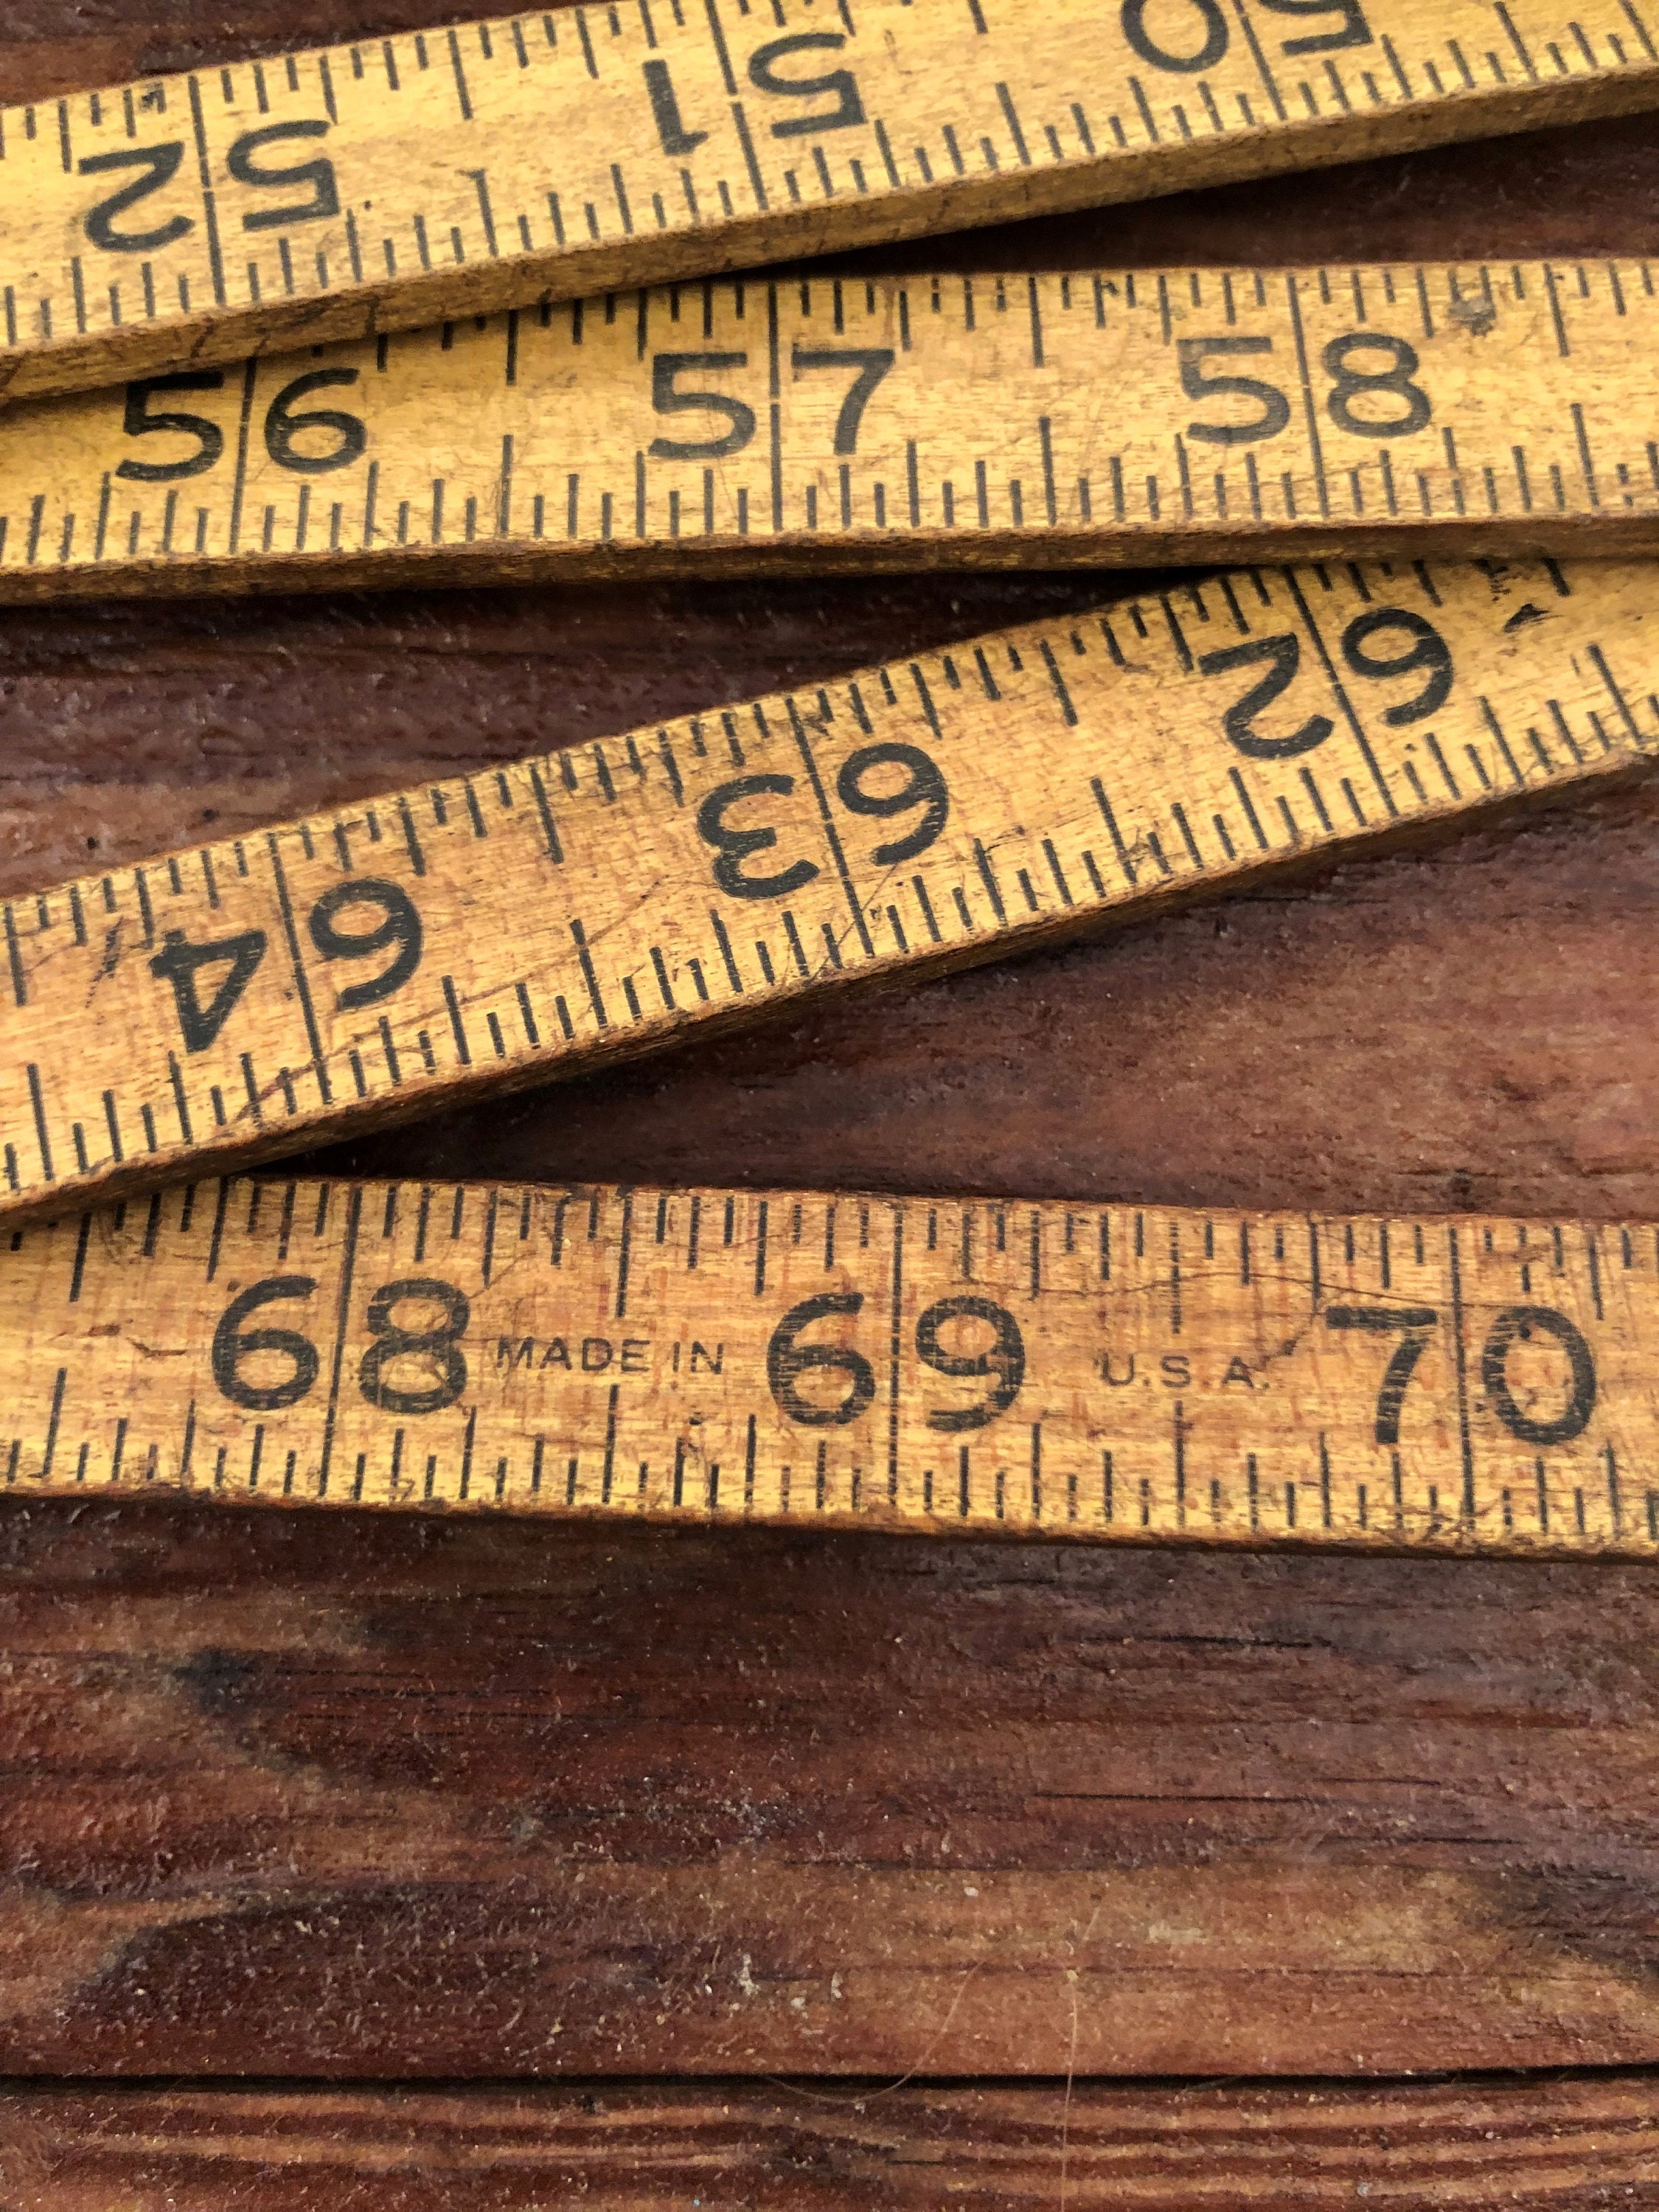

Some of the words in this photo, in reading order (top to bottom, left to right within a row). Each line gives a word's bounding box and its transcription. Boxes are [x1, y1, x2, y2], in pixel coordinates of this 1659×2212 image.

[642, 32, 866, 154] 51
[77, 119, 341, 253] 52
[115, 369, 367, 481] 56
[648, 351, 895, 459] 57
[1179, 333, 1432, 440] 58
[1197, 608, 1455, 759] 62
[696, 742, 950, 900] 63
[149, 877, 423, 1053] 64
[211, 1274, 471, 1415] 68
[496, 1336, 650, 1374] MADE
[672, 1341, 723, 1375] IN
[766, 1292, 1026, 1433] 69
[1326, 1304, 1598, 1446] 70
